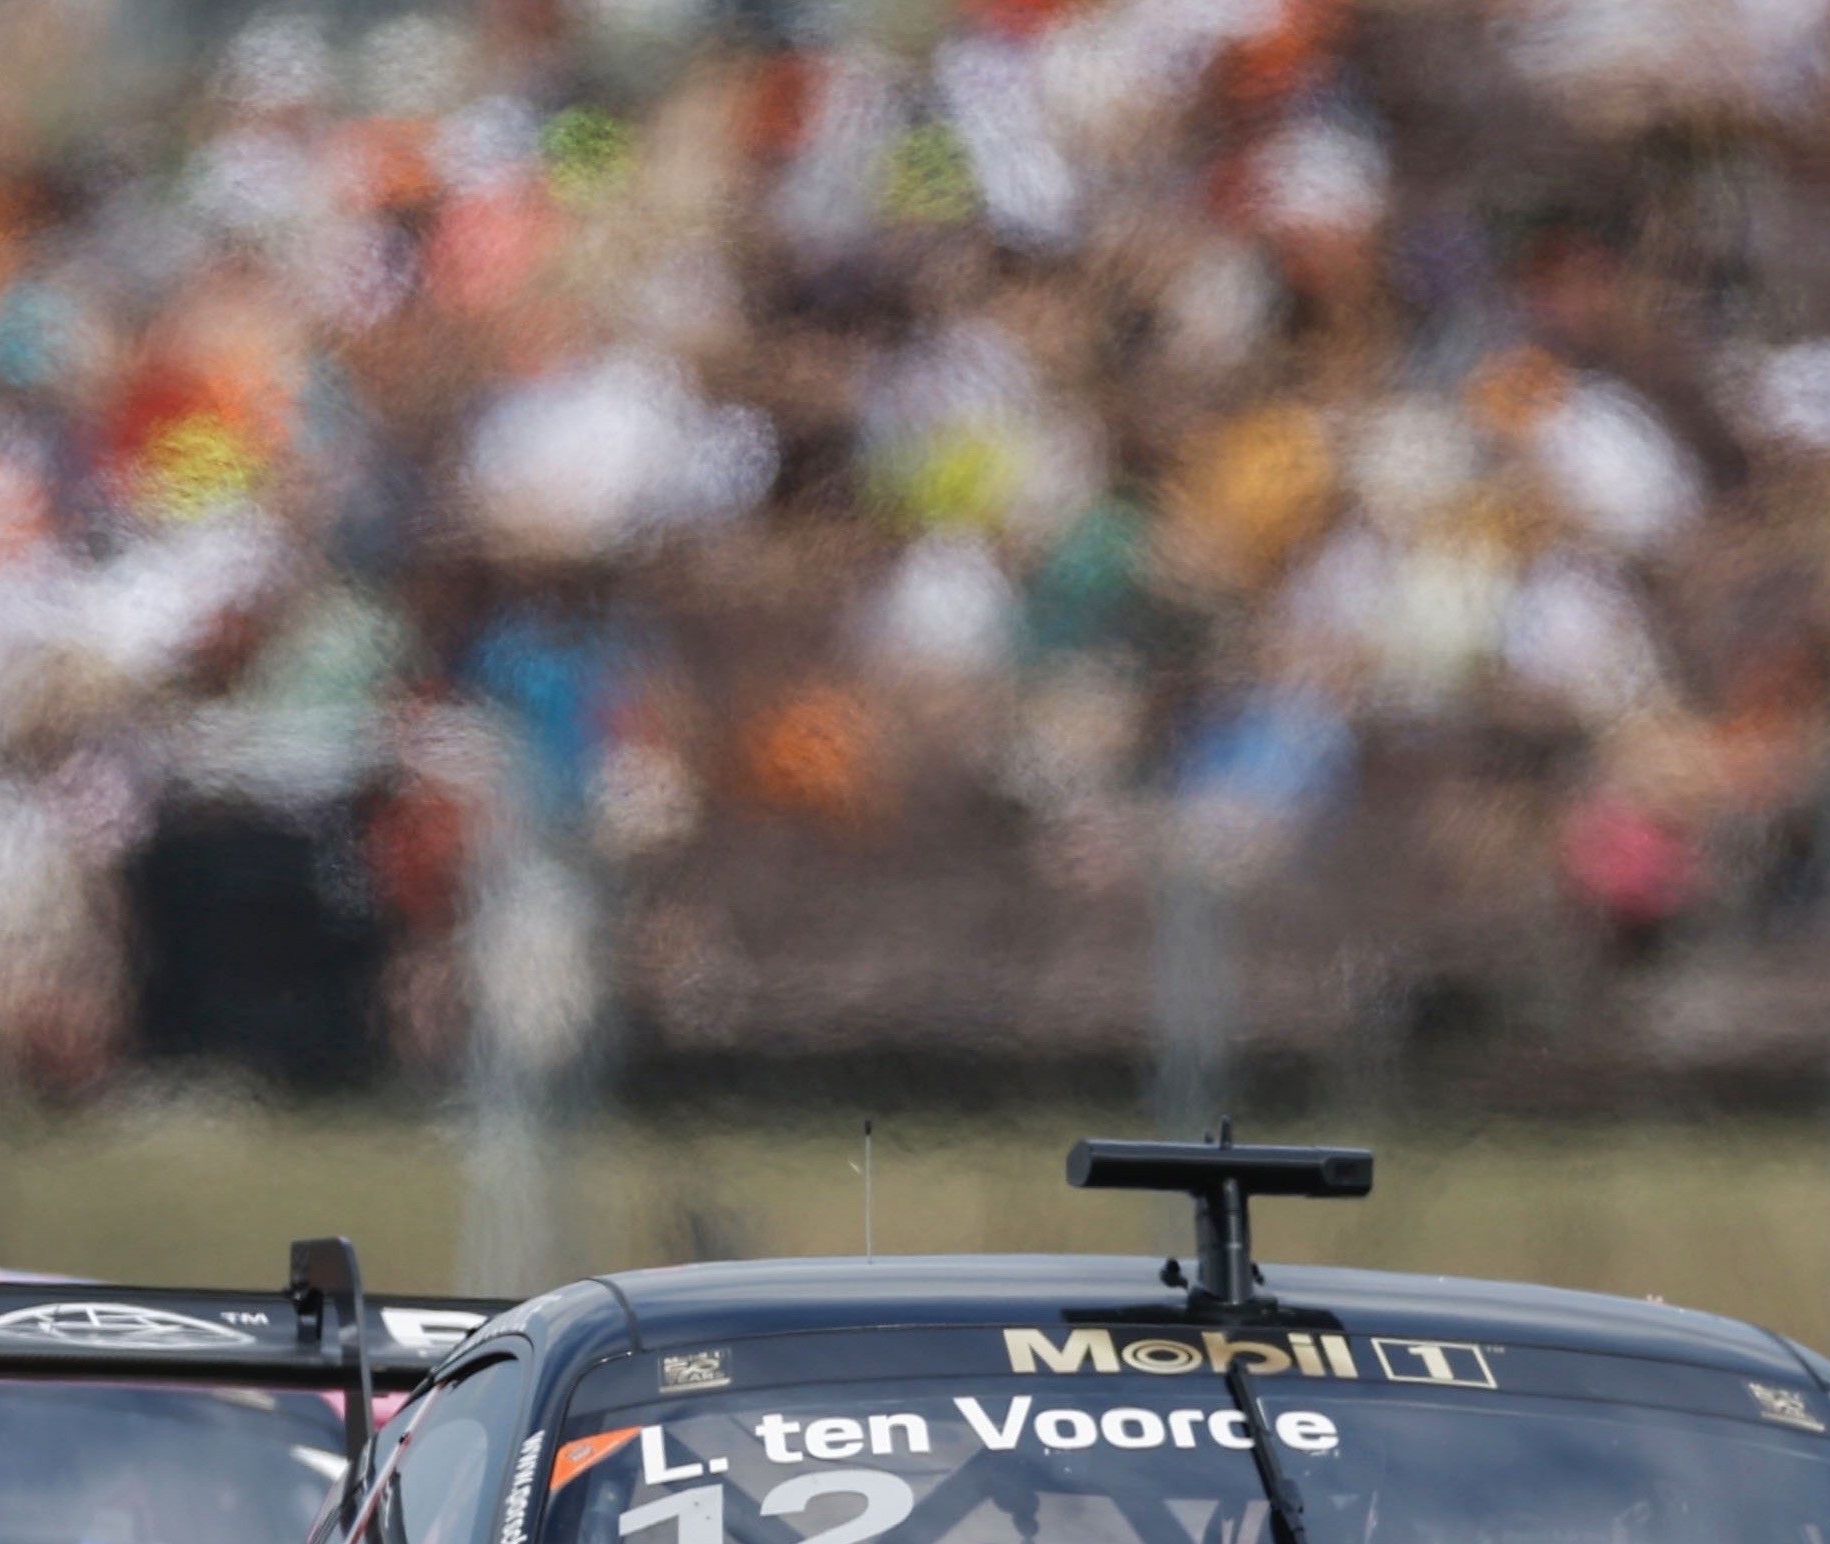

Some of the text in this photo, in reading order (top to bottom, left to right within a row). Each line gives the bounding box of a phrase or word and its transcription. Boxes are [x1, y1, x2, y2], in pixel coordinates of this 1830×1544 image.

[1002, 1328, 1359, 1379] Mobil
[639, 1424, 729, 1485] L.
[756, 1412, 931, 1466] ten
